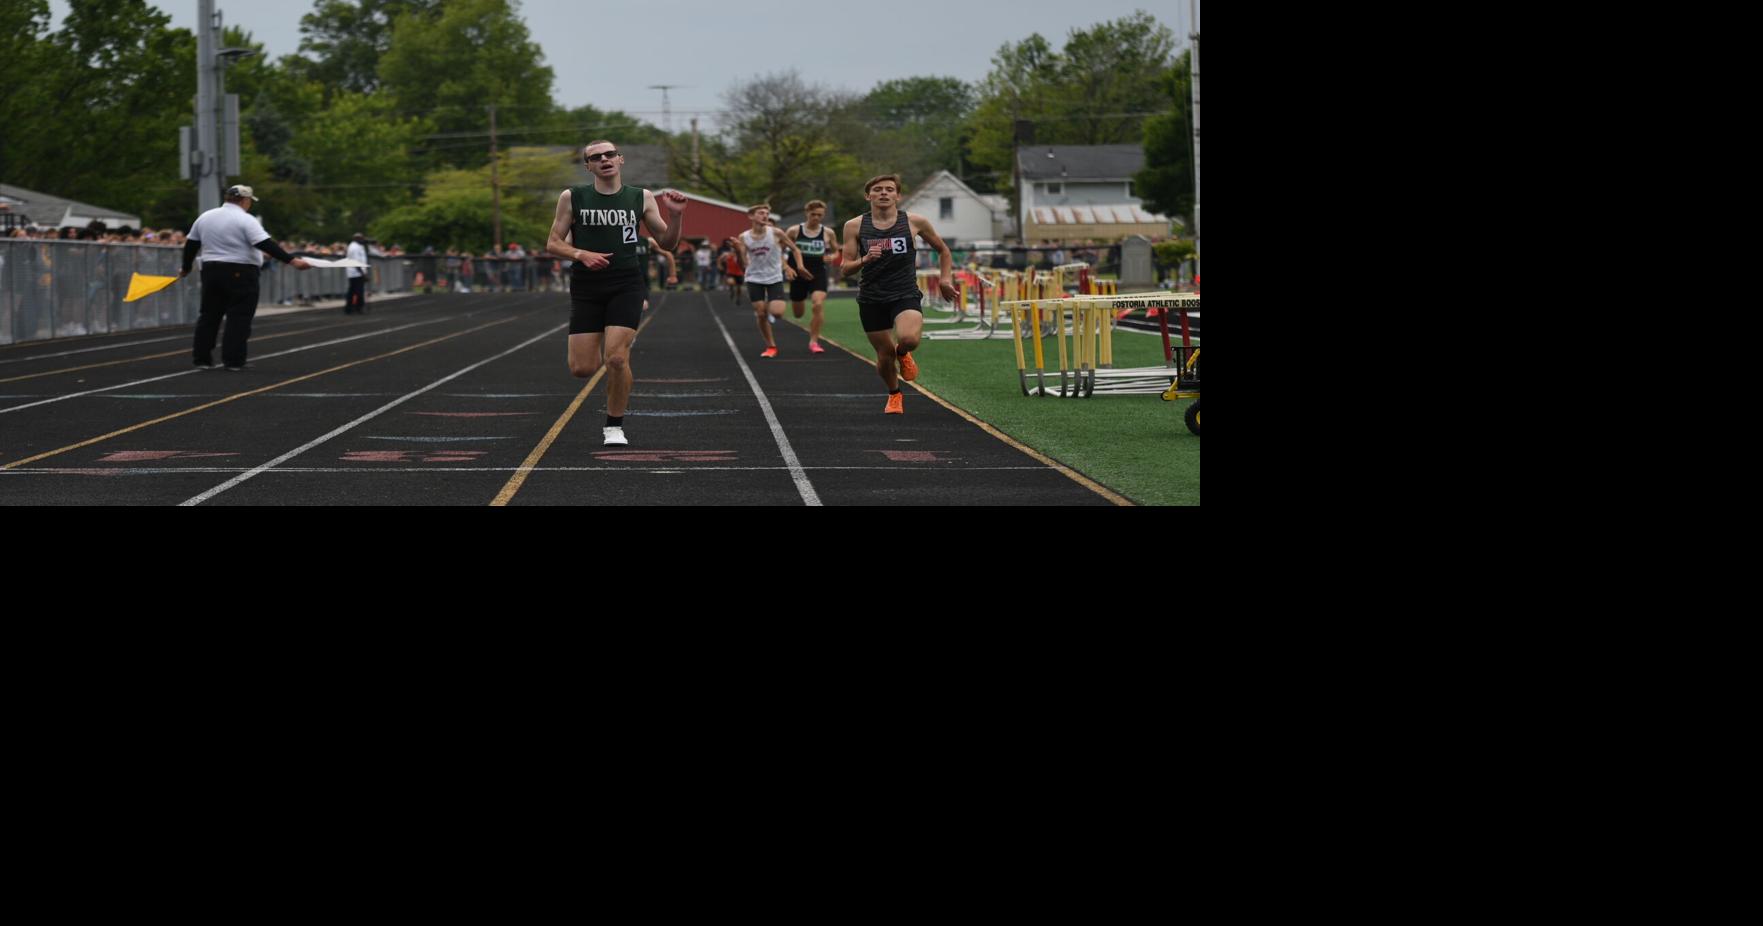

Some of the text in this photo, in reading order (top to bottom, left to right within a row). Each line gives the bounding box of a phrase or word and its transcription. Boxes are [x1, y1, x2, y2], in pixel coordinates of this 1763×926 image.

[580, 209, 637, 226] TINORA
[624, 226, 635, 242] 2
[893, 239, 905, 253] 3
[1112, 300, 1146, 309] FOSTORIA
[1147, 300, 1179, 308] ATHLETIC
